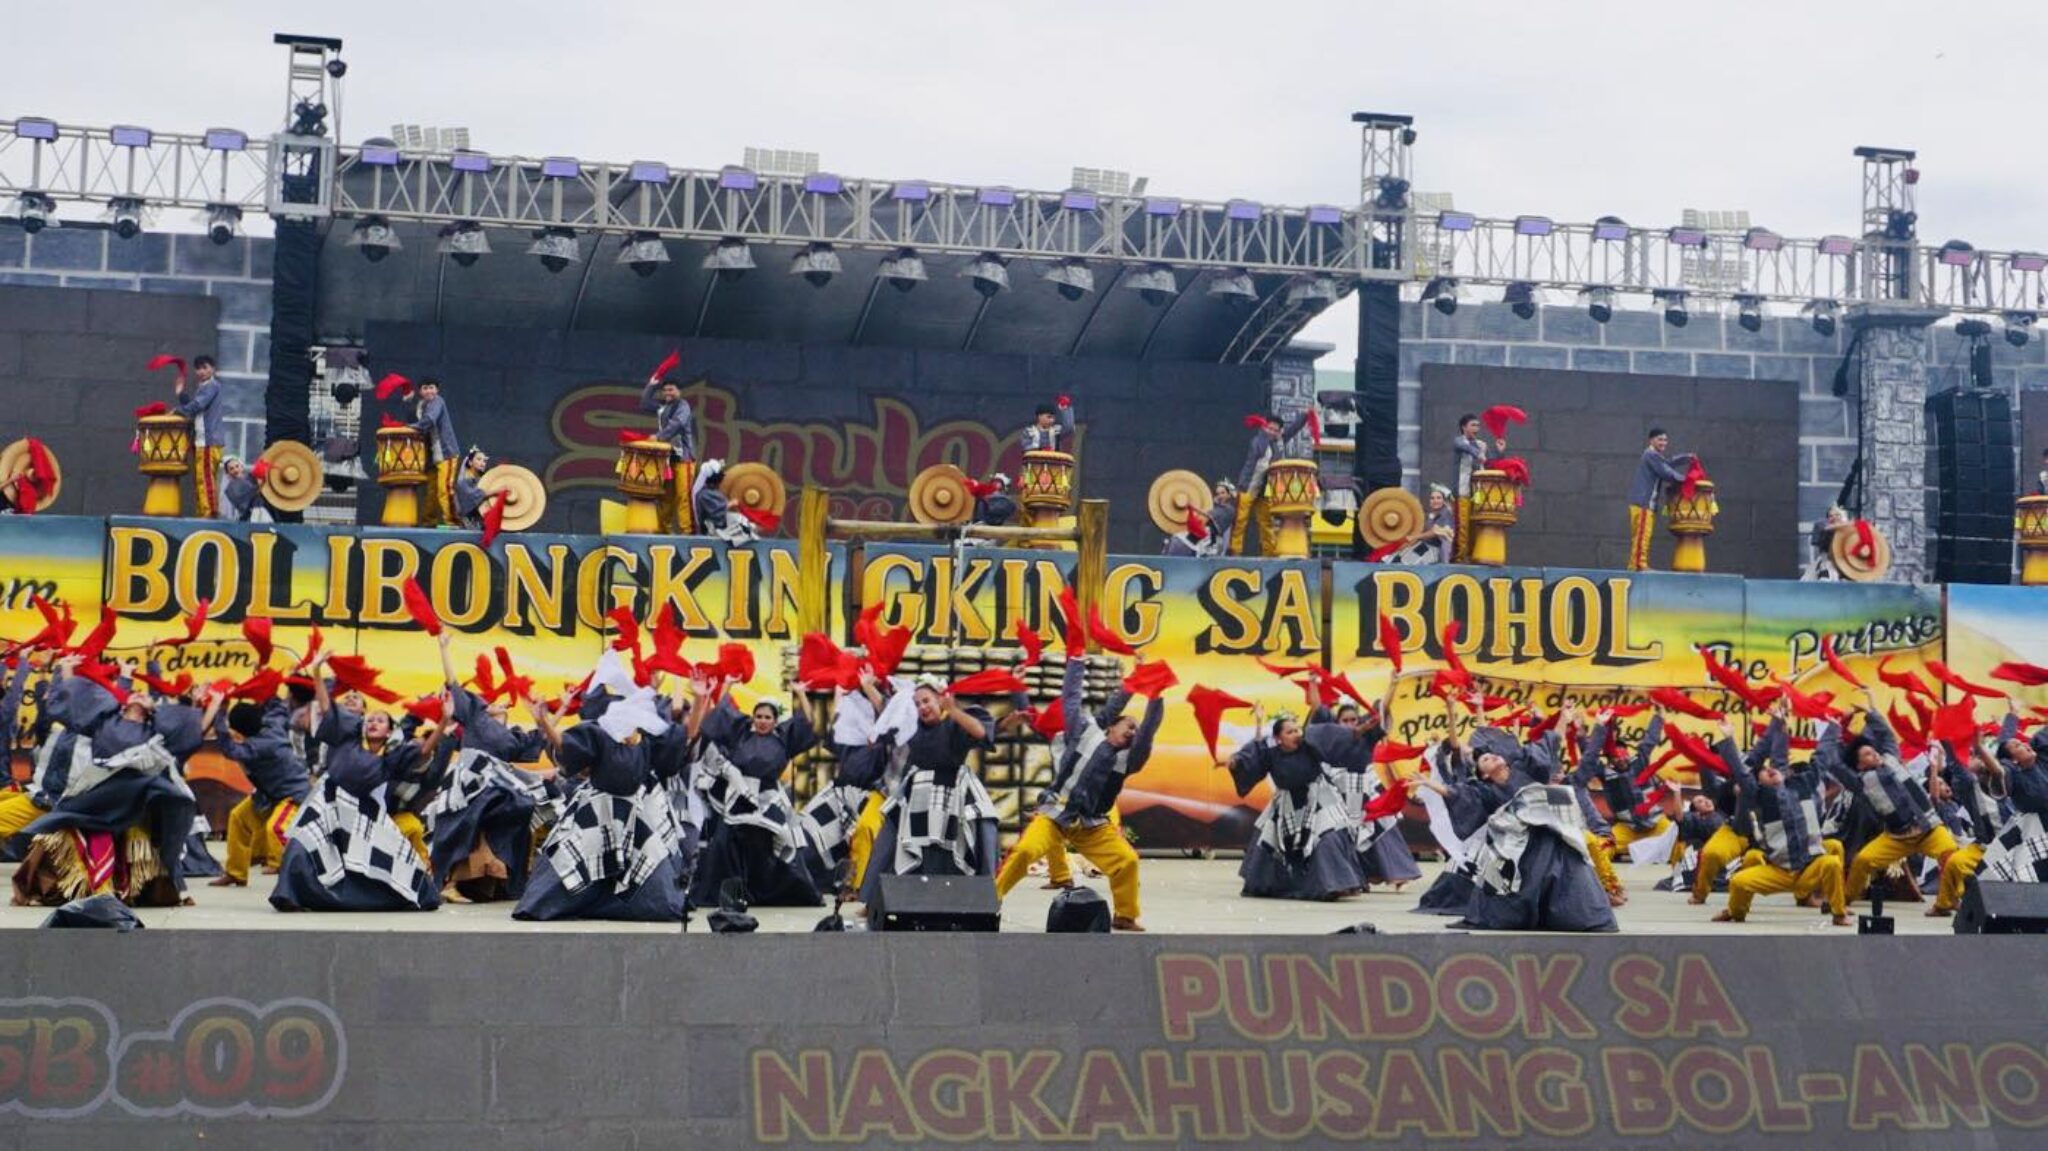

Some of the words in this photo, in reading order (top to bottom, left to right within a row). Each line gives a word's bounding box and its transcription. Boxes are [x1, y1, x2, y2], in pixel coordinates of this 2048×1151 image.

[1210, 568, 1322, 652] SA
[1372, 570, 1664, 660] BOHOL
[1786, 613, 1942, 680] Purpose
[1156, 952, 1597, 1041] PUNDOK
[1609, 952, 1749, 1039] SA
[752, 1046, 1595, 1143] NAGKAHIUSANG
